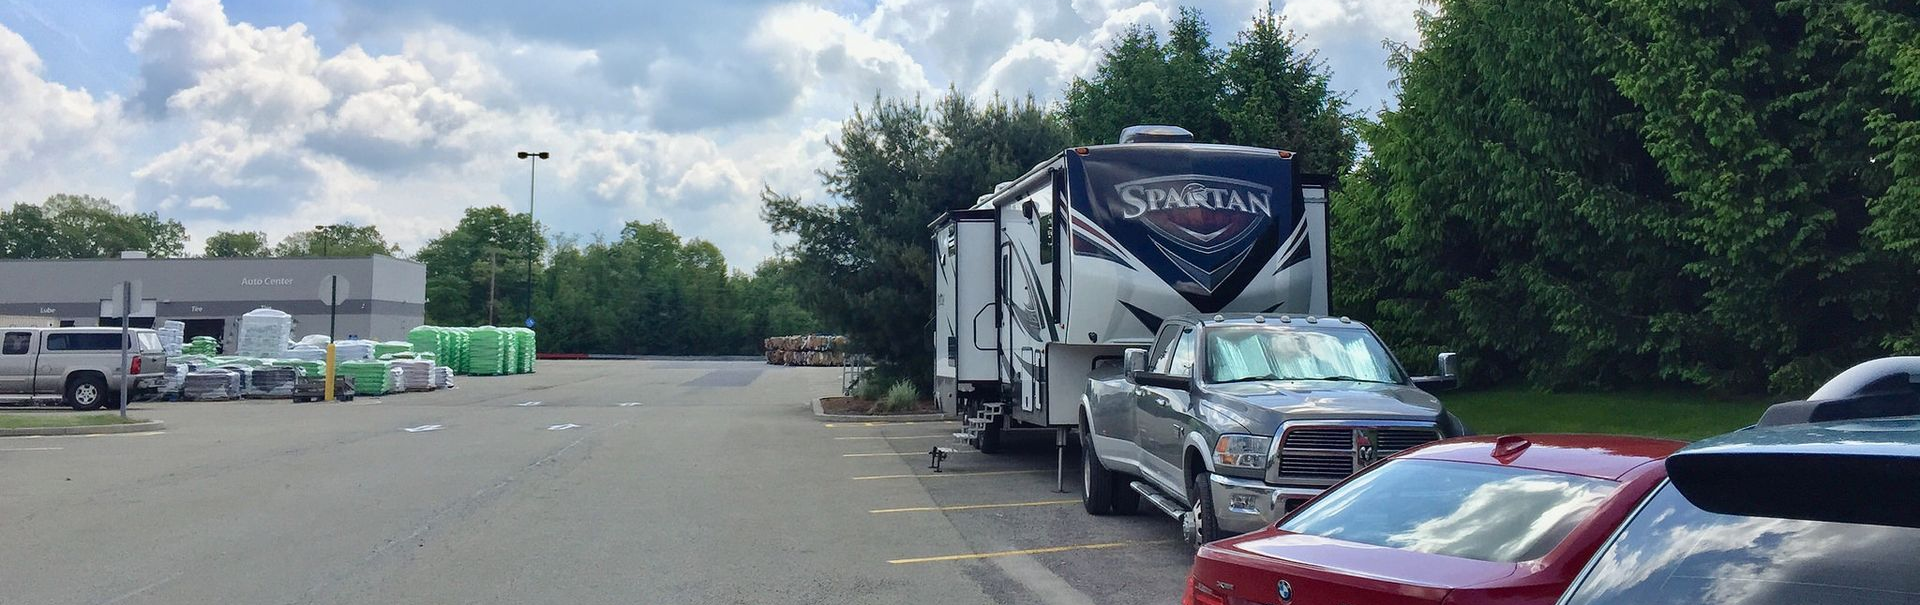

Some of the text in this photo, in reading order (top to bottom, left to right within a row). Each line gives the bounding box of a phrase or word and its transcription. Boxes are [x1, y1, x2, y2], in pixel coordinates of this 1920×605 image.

[1121, 185, 1272, 219] SPARTAN
[241, 278, 294, 286] Auto Center
